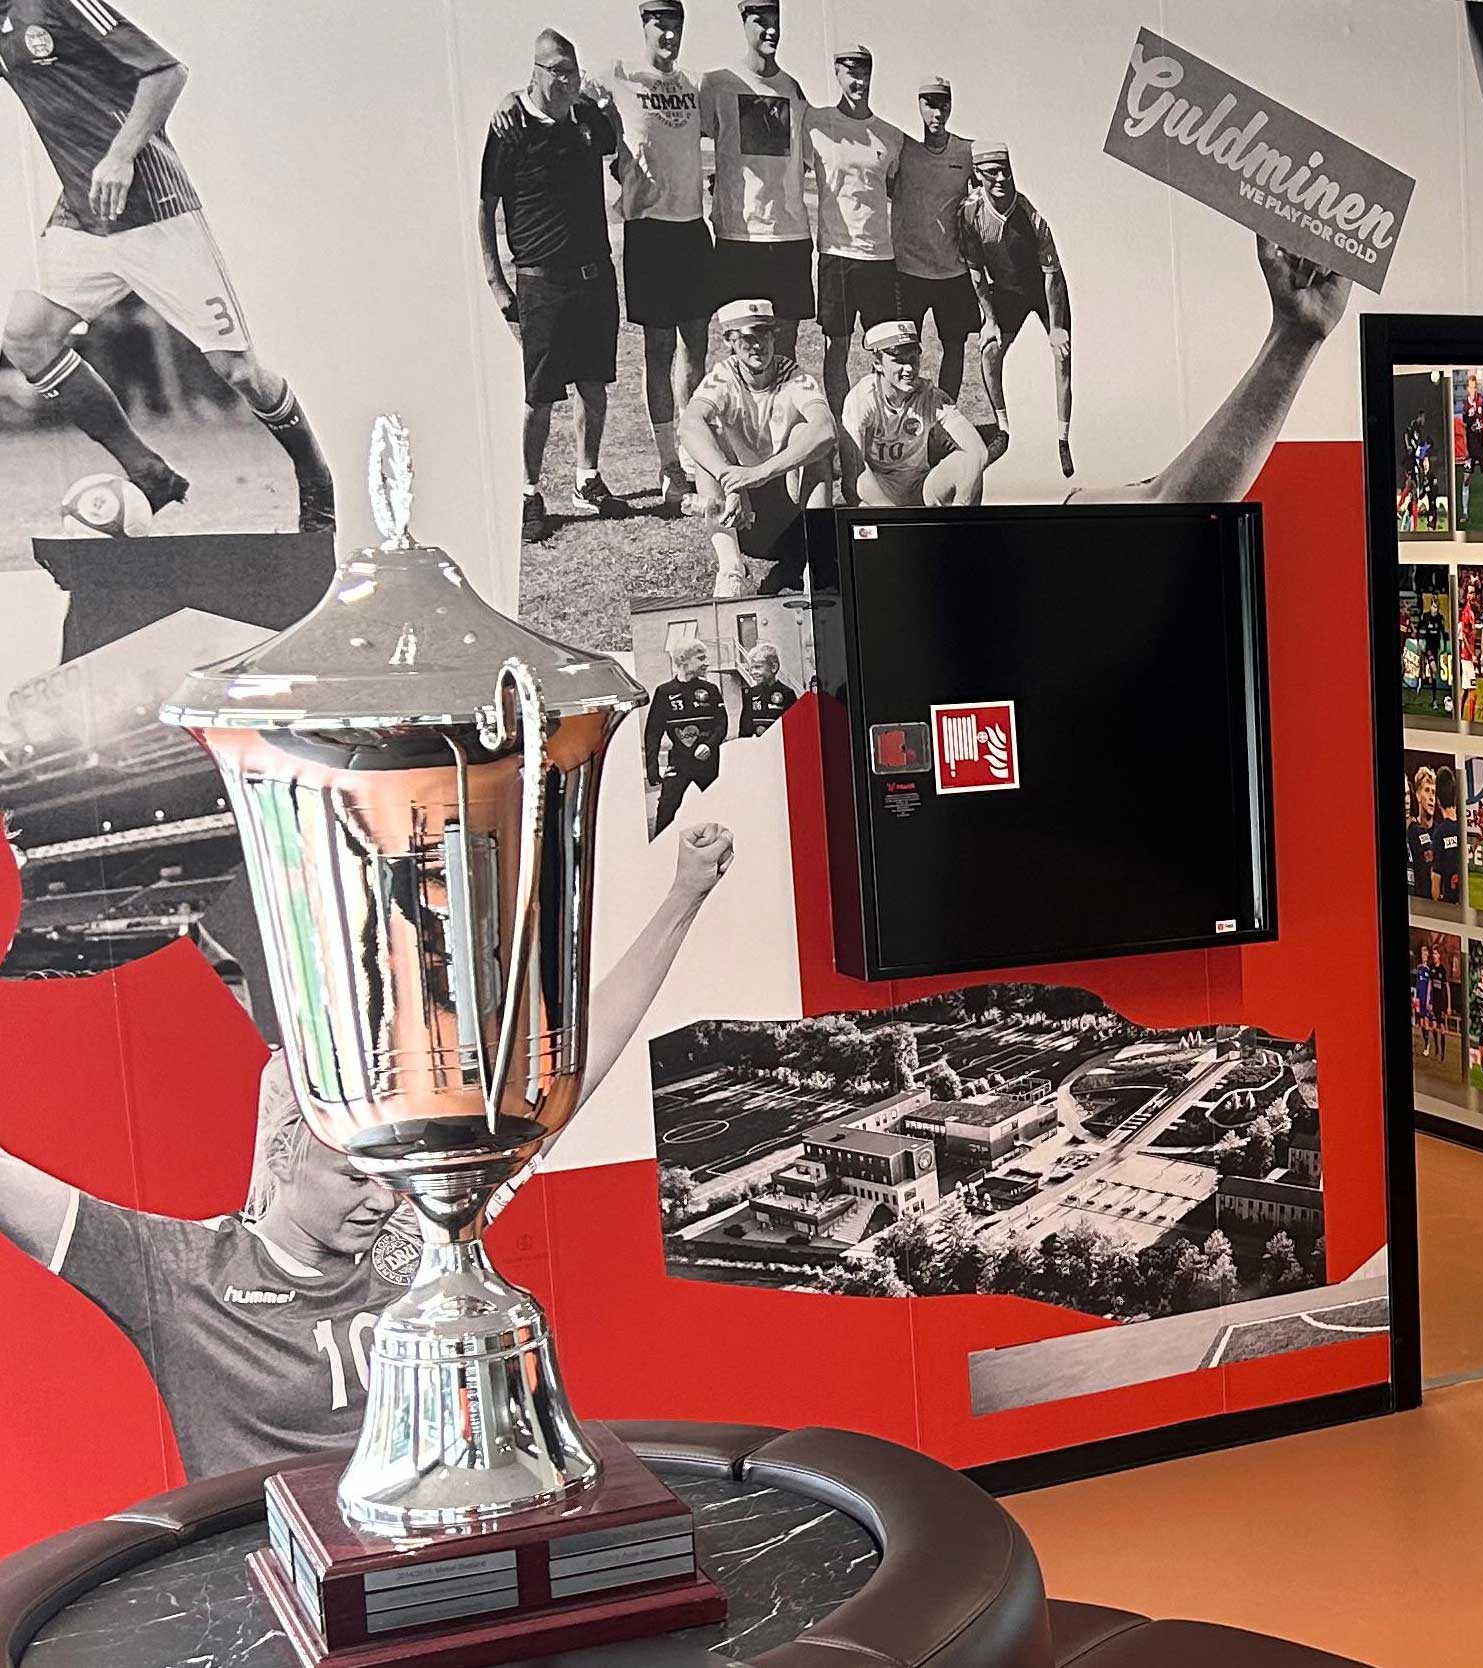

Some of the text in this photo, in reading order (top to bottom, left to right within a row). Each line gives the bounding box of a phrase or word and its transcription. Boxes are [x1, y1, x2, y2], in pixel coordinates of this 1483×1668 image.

[636, 93, 696, 110] TOMMY
[1124, 43, 1395, 249] Guldminen
[1240, 180, 1377, 264] WE PLAY FOR GOLD
[205, 296, 234, 336] 3
[876, 441, 904, 461] 10
[223, 1285, 296, 1304] hummel
